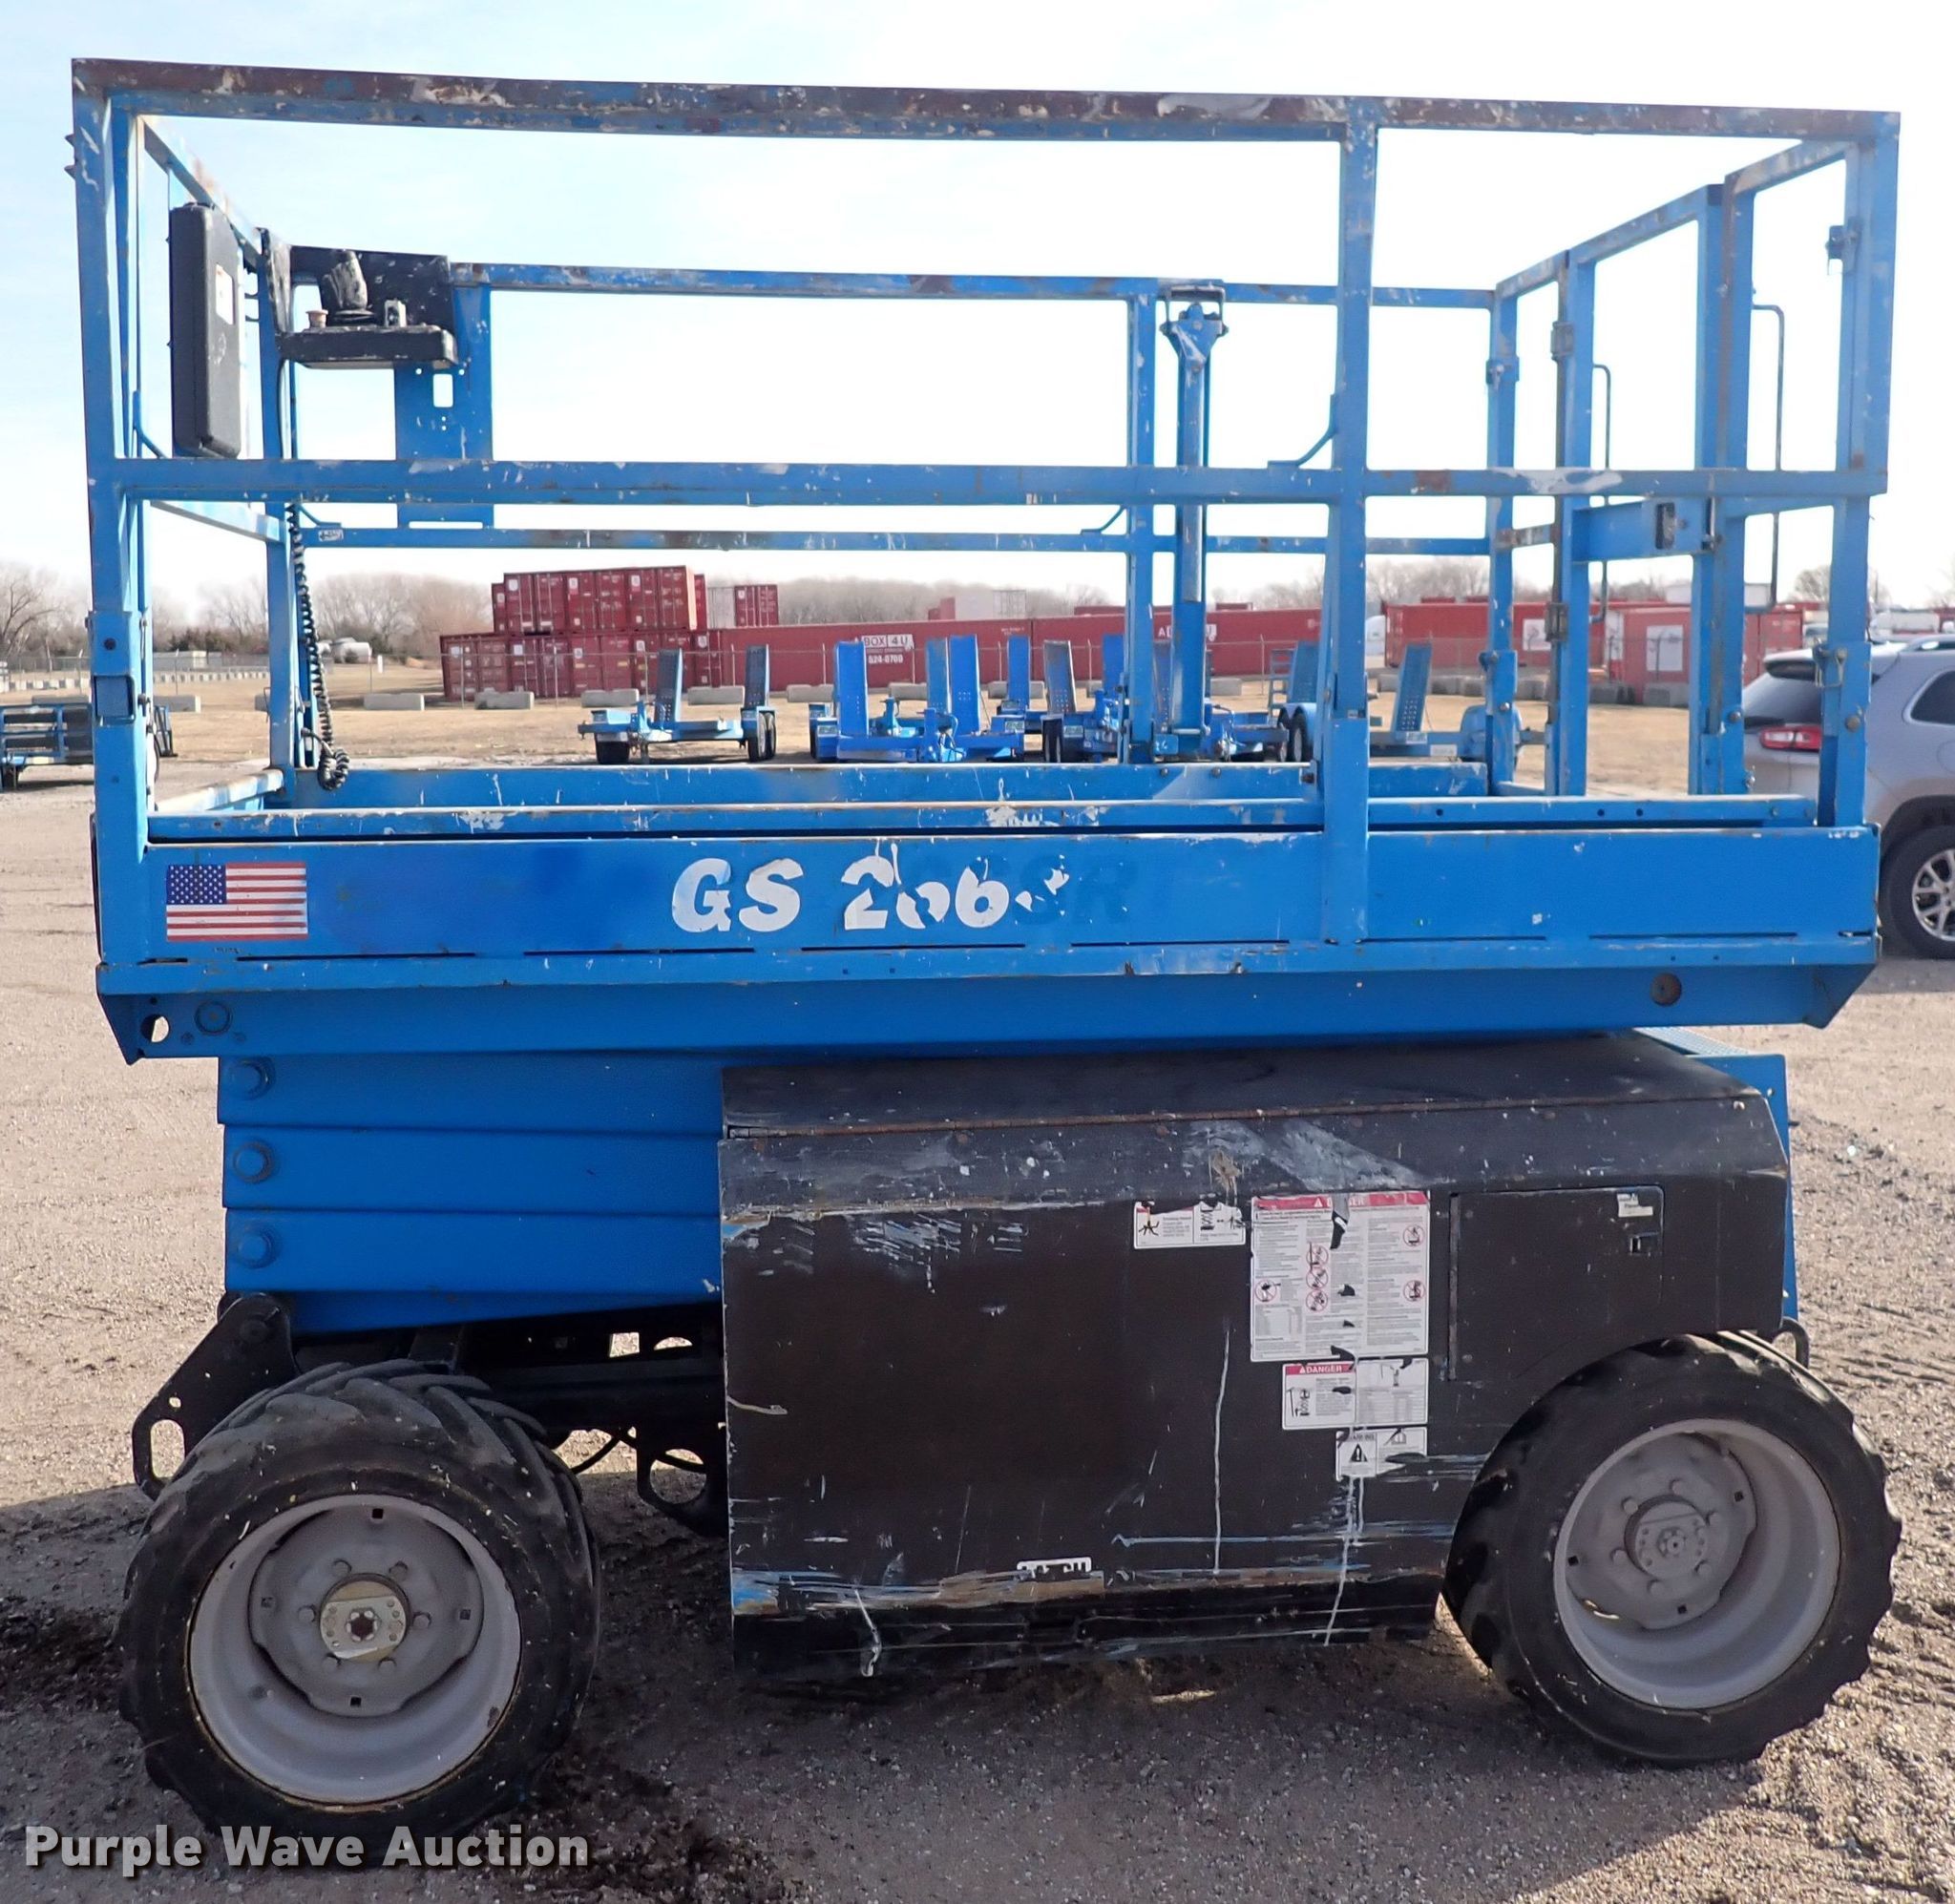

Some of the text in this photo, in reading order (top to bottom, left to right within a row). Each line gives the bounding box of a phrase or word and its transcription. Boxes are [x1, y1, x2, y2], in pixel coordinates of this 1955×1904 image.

[864, 637, 886, 646] BOX
[671, 857, 804, 932] GS
[1306, 1364, 1343, 1374] DANGER
